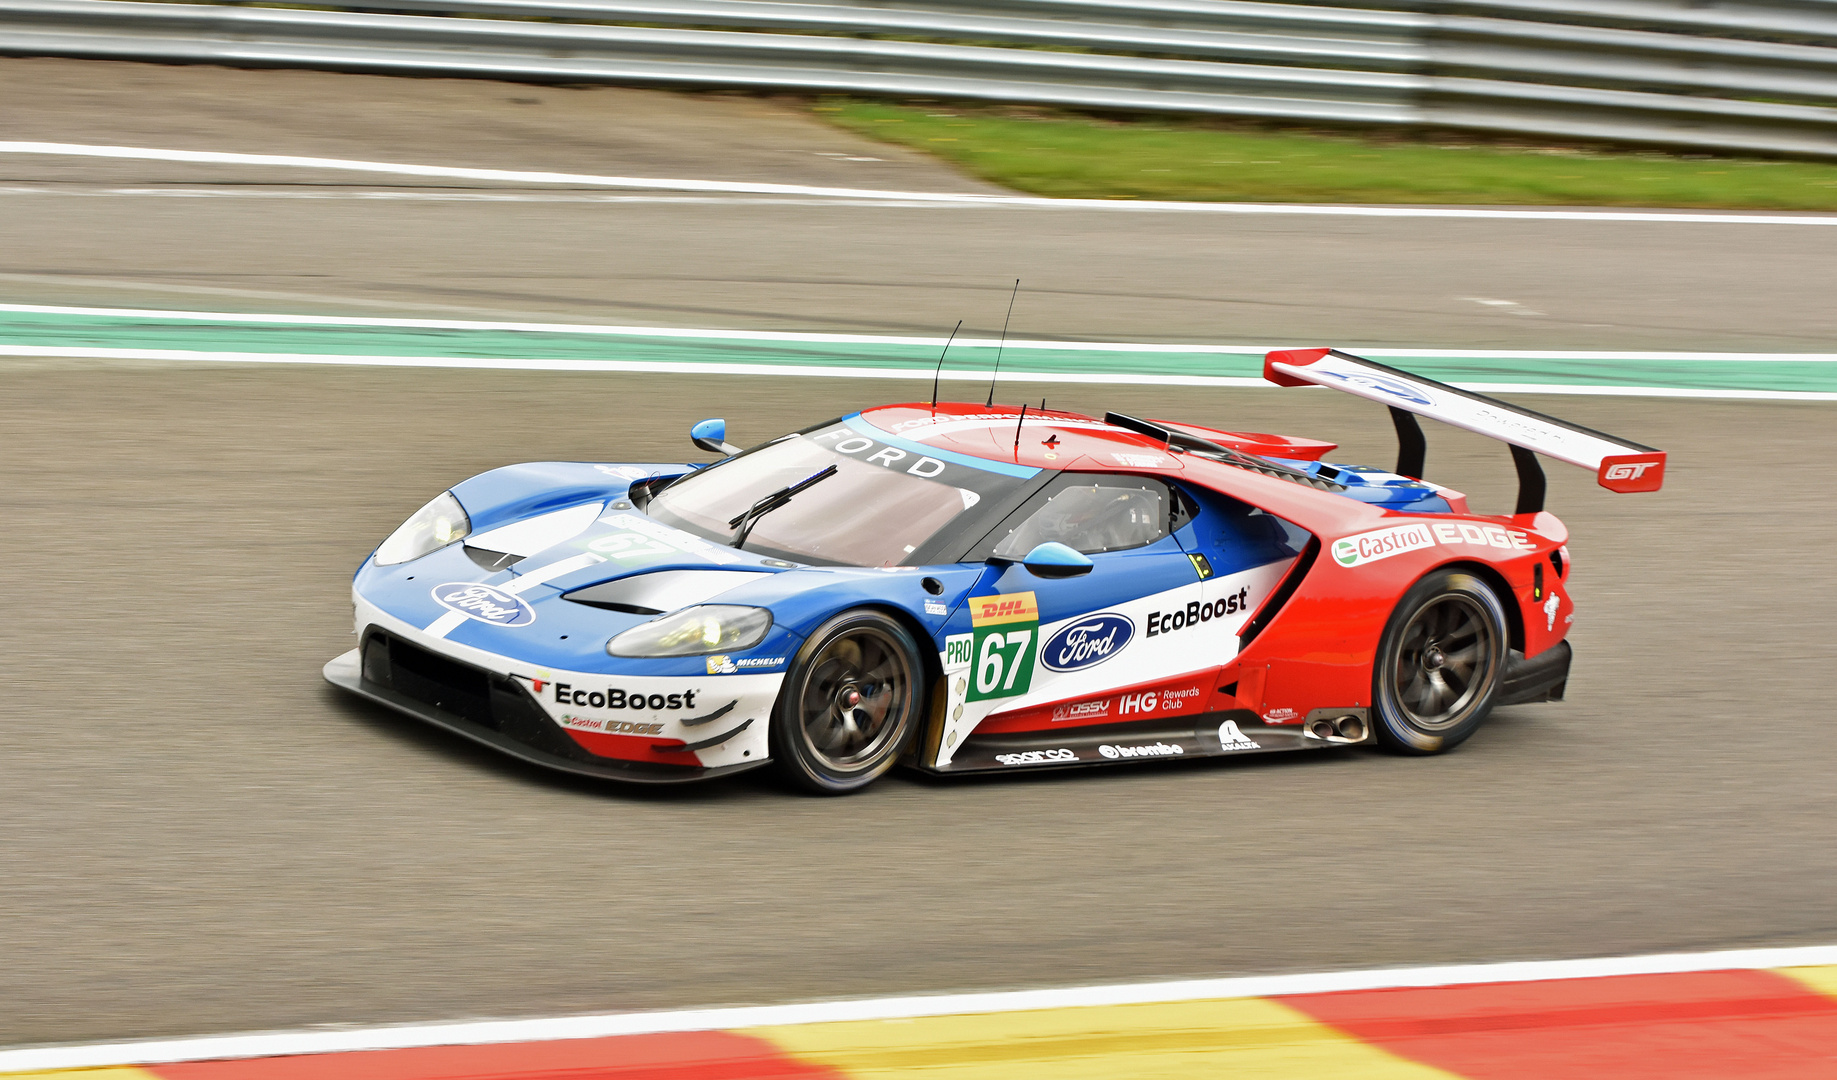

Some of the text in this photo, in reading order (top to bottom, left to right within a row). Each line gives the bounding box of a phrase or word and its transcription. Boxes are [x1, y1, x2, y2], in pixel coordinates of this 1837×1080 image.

[812, 427, 946, 478] FORD
[1605, 462, 1660, 480] GT
[1358, 523, 1537, 559] Castrol EDGE
[443, 586, 520, 620] Ford
[981, 600, 1028, 618] DHL
[1146, 587, 1248, 638] EcoBoost
[948, 639, 971, 664] PRO
[1058, 622, 1119, 666] Ford
[737, 657, 786, 667] MICHELIN
[976, 630, 1032, 694] 67
[555, 682, 697, 710] EcoBoost
[1119, 692, 1158, 715] IHG
[1162, 699, 1183, 710] Club
[1163, 687, 1200, 699] Rewards
[571, 716, 665, 735] Castrol EDGE
[995, 748, 1076, 765] sparco
[1115, 742, 1184, 757] brembo
